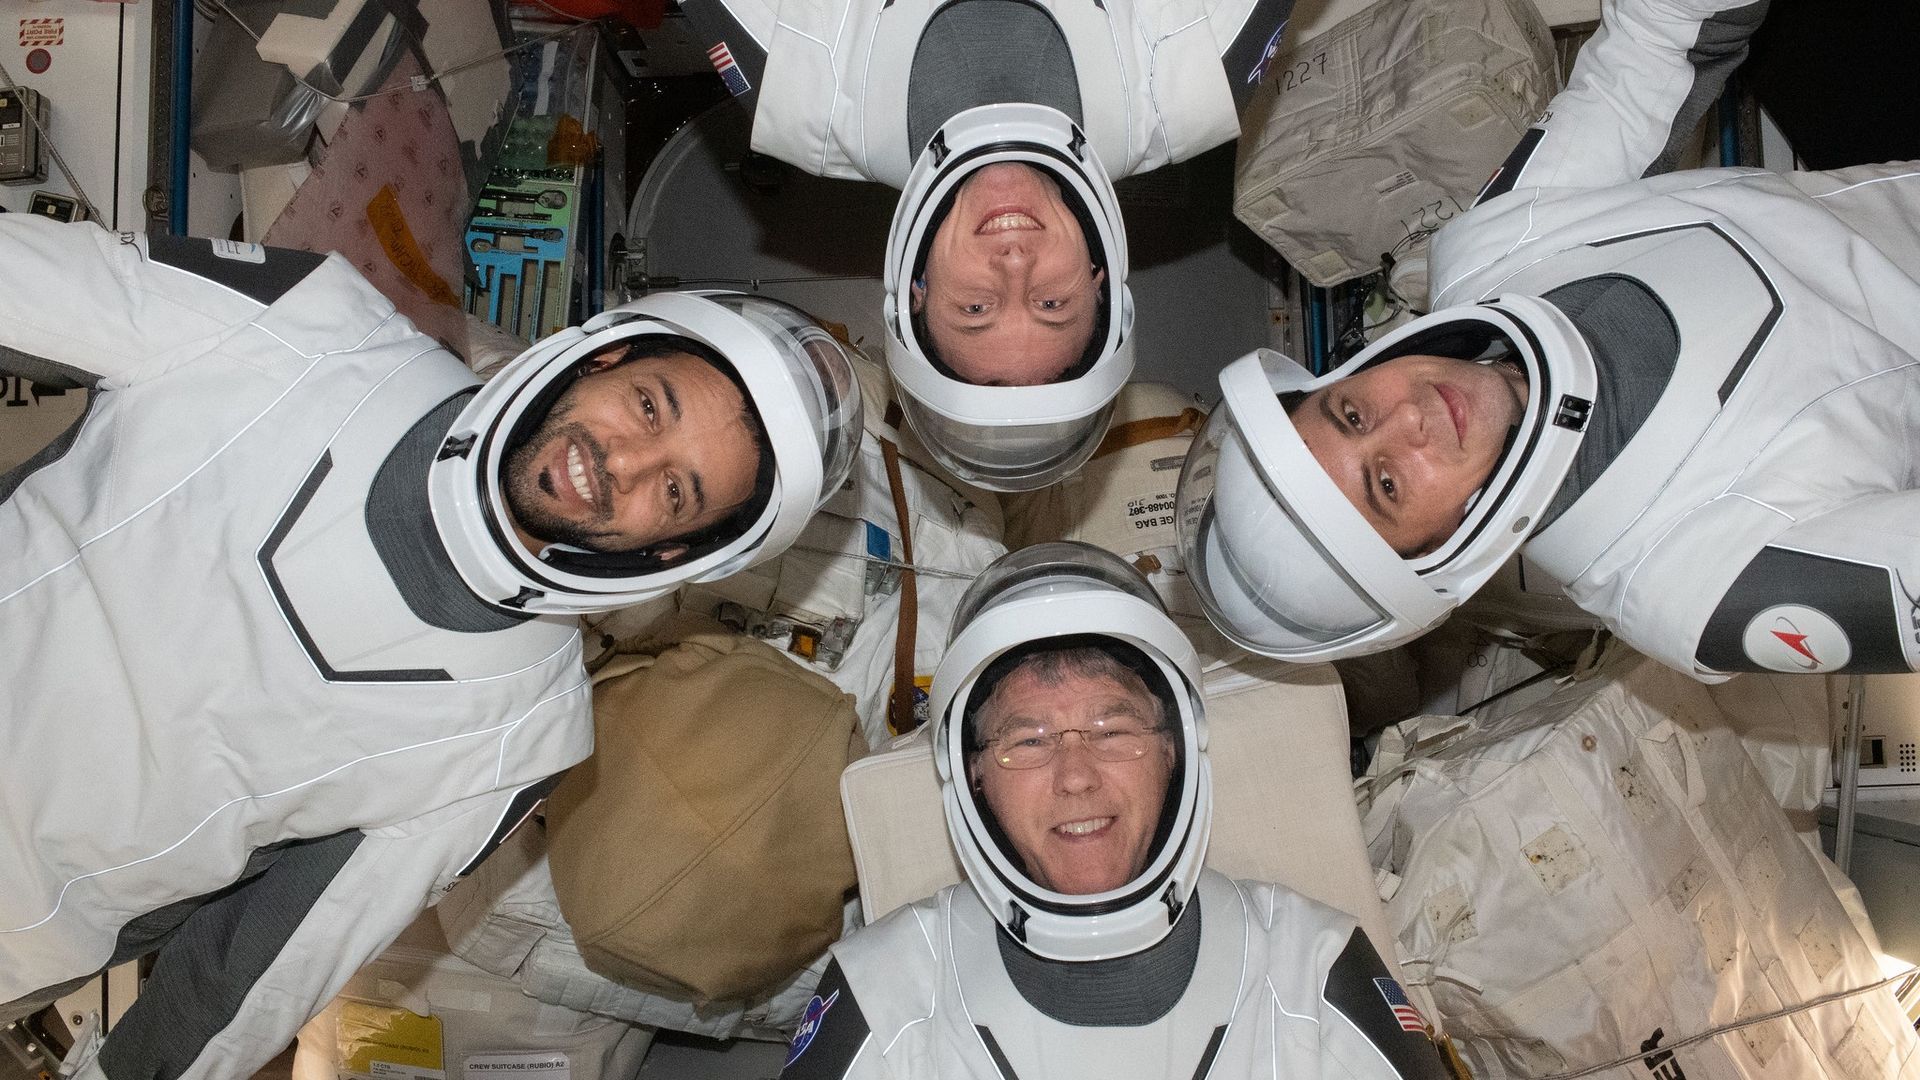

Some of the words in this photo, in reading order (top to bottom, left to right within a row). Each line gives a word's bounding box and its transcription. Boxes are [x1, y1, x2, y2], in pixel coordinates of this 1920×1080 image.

[1273, 52, 1328, 95] 1227
[1135, 518, 1157, 529] BAG
[527, 1061, 554, 1070] (RUBIO)
